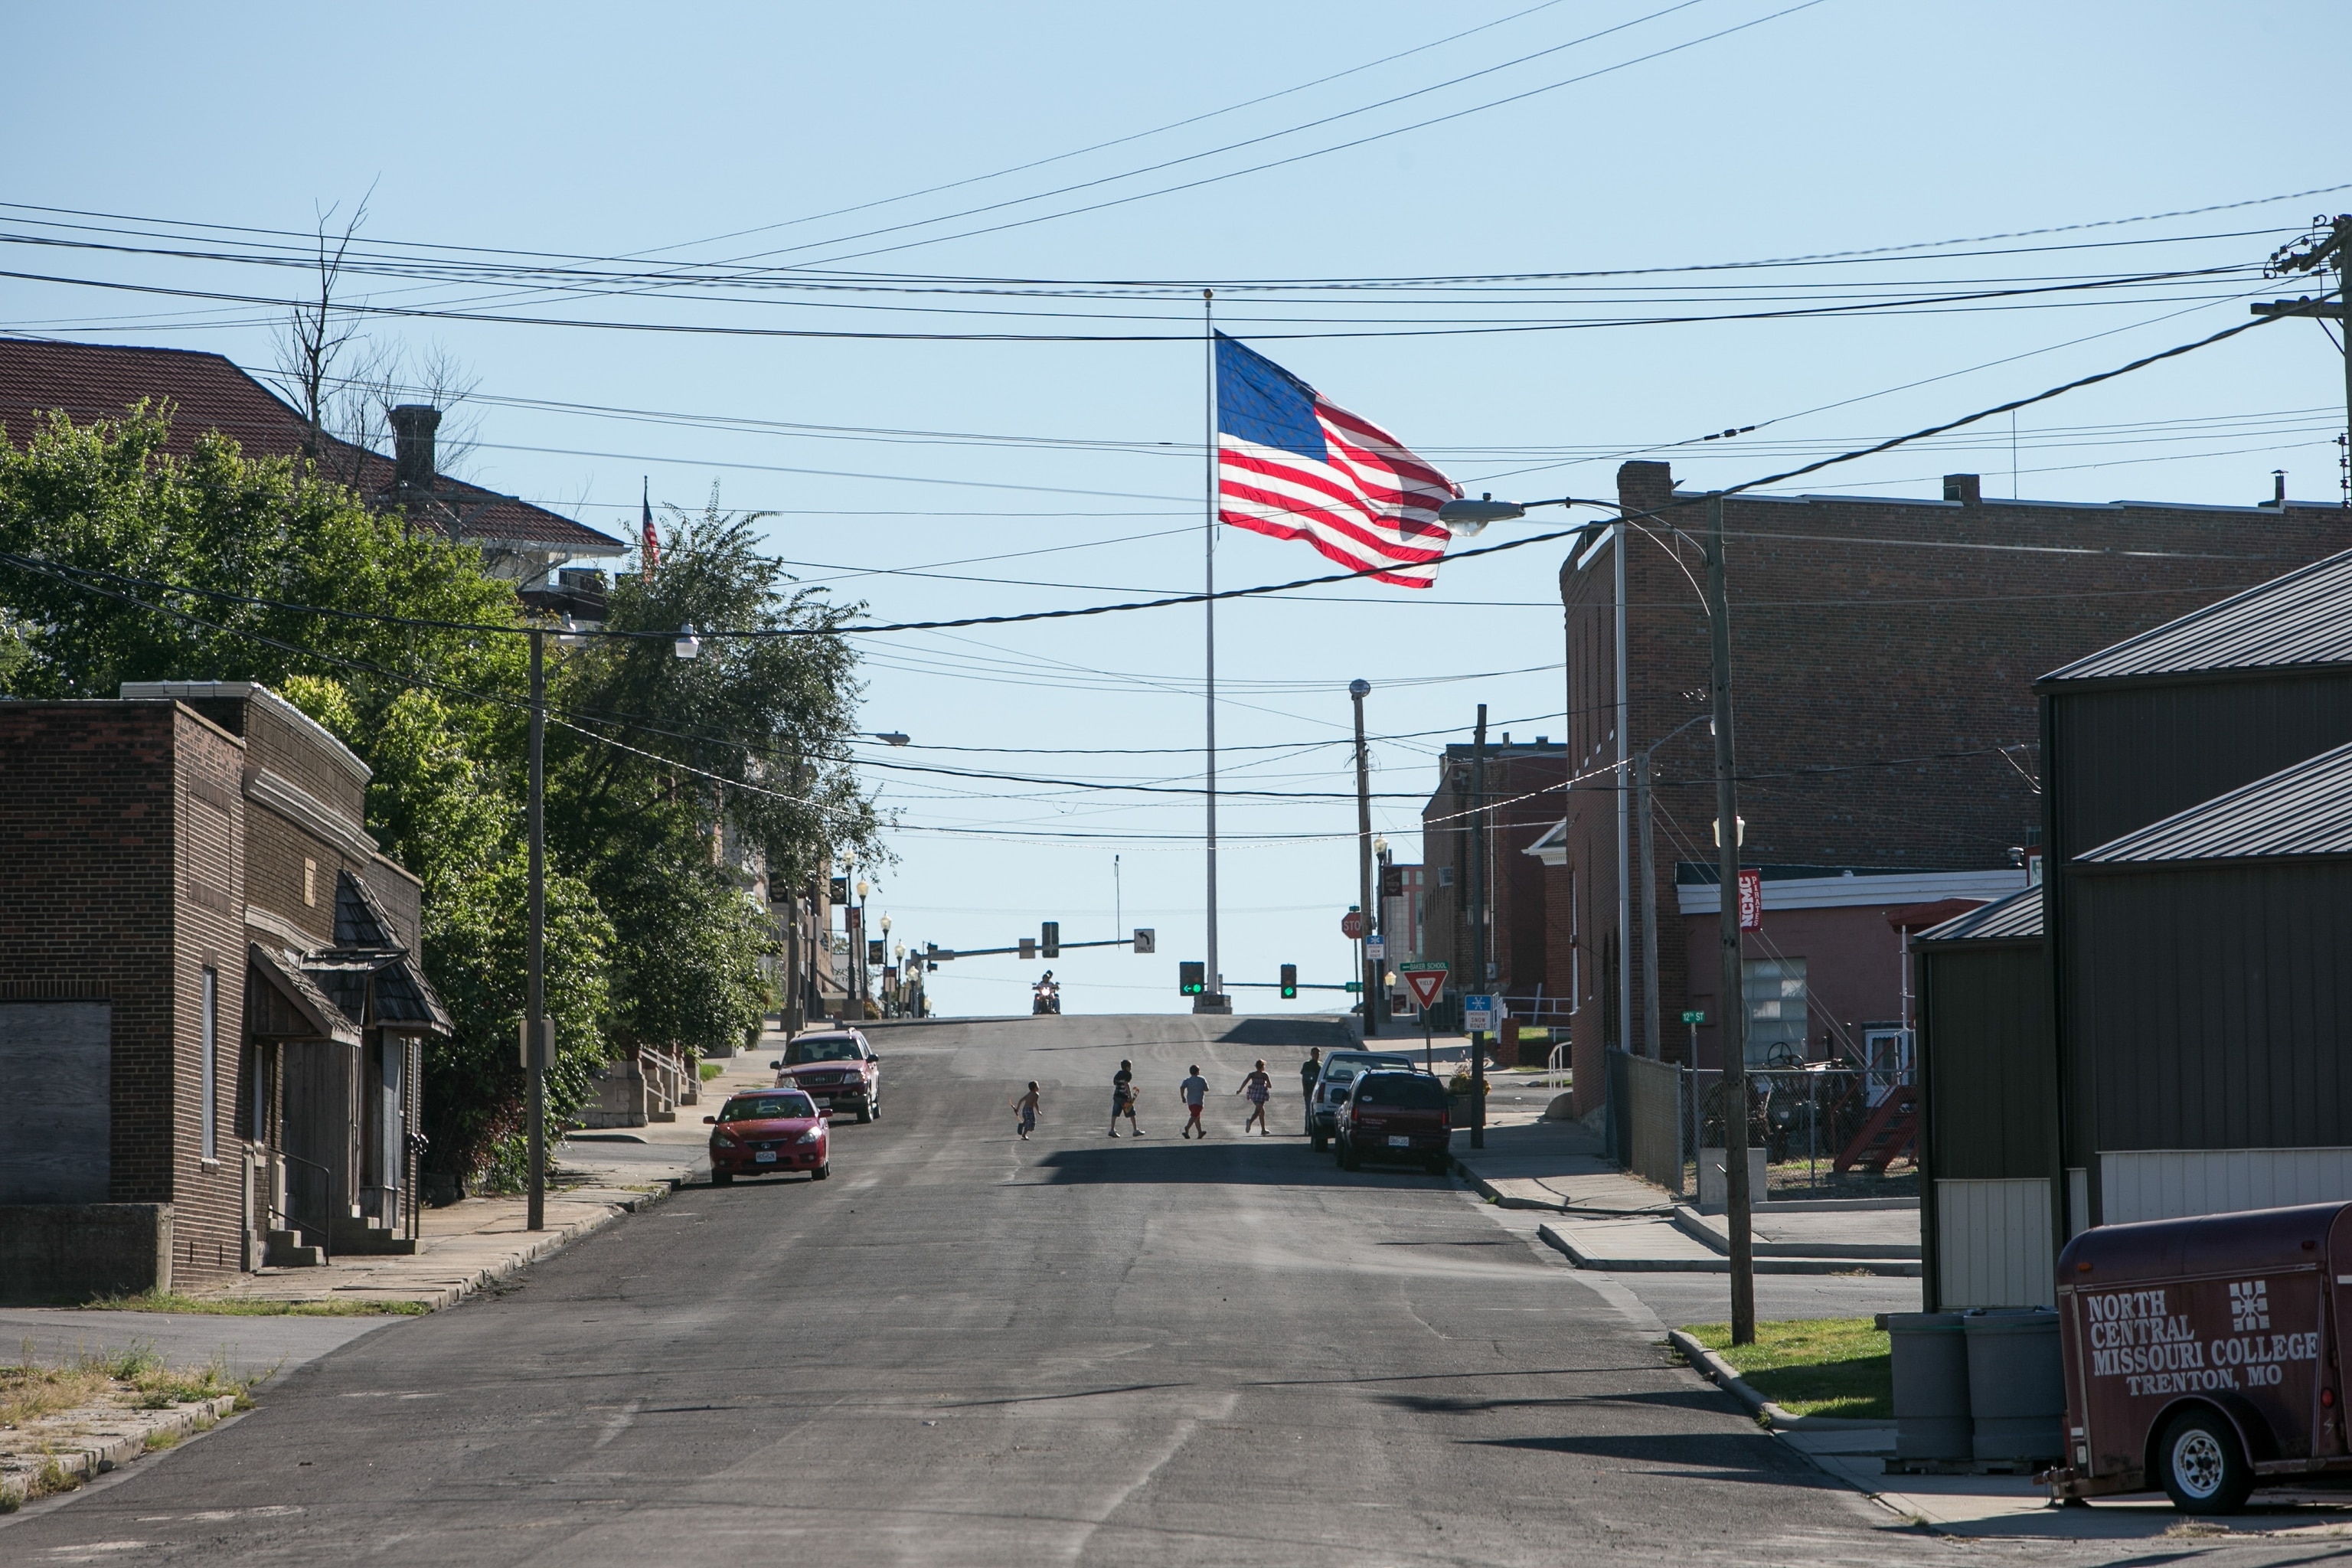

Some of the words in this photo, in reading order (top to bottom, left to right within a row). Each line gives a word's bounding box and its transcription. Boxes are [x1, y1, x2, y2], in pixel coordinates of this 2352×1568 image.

[1739, 876, 1754, 928] NCMC
[1752, 876, 1760, 926] PIRATES
[1343, 920, 1361, 931] STO
[1696, 1011, 1704, 1021] ST
[2087, 1290, 2167, 1322] NORTH
[2090, 1315, 2194, 1348] CENTRAL
[2092, 1341, 2204, 1376] MISSOURI
[2211, 1332, 2318, 1366] COLLEGE
[2127, 1368, 2239, 1396] TRENTON,
[2248, 1364, 2282, 1387] MO
